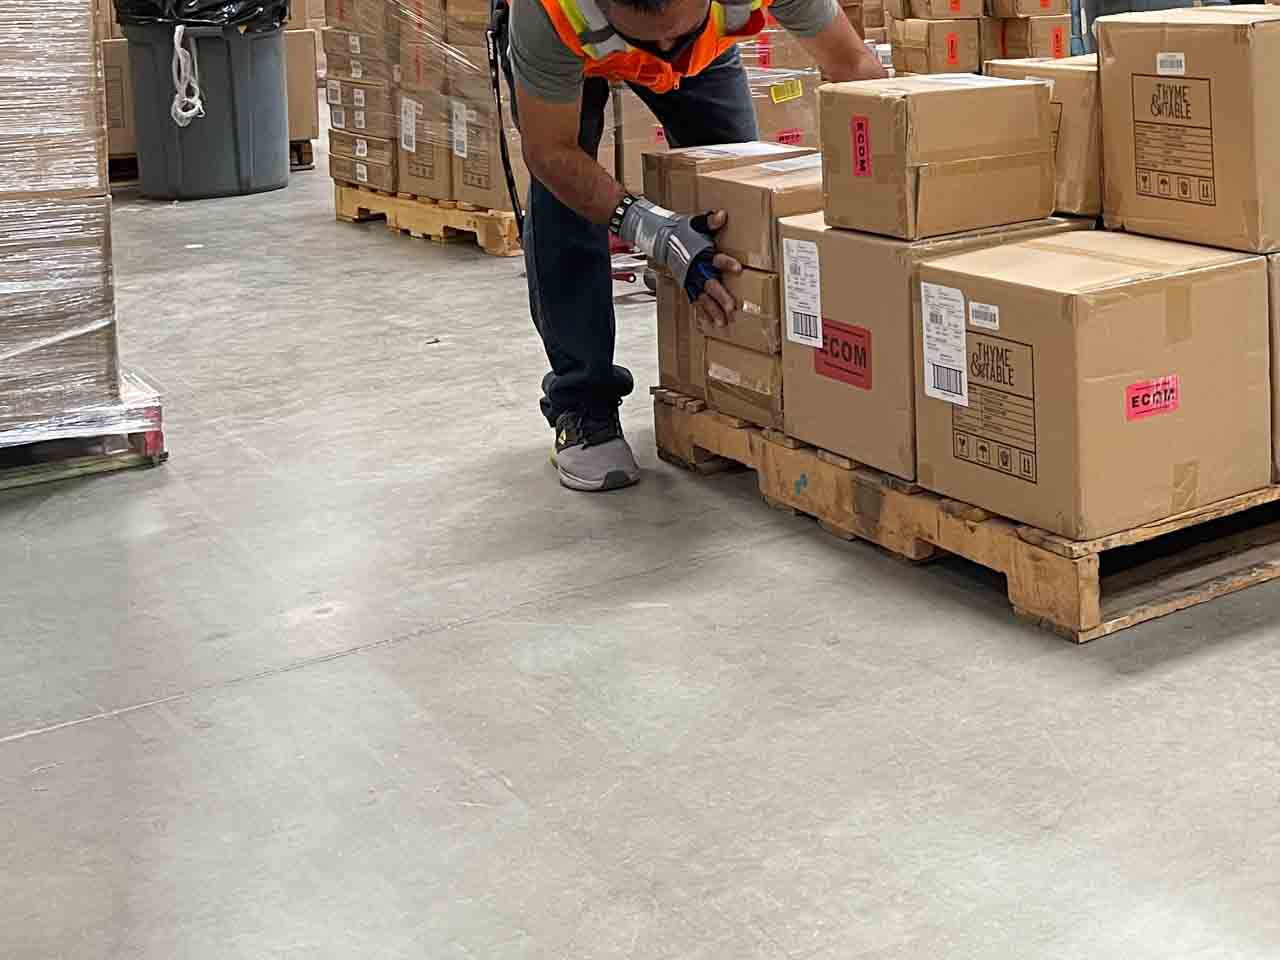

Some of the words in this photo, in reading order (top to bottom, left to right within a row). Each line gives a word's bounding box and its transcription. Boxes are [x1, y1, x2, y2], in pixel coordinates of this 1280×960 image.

[1155, 83, 1192, 103] THYME
[1162, 101, 1192, 120] TABLE
[856, 122, 866, 171] ECOM
[976, 342, 1013, 367] THYME
[985, 362, 1014, 386] TABLE
